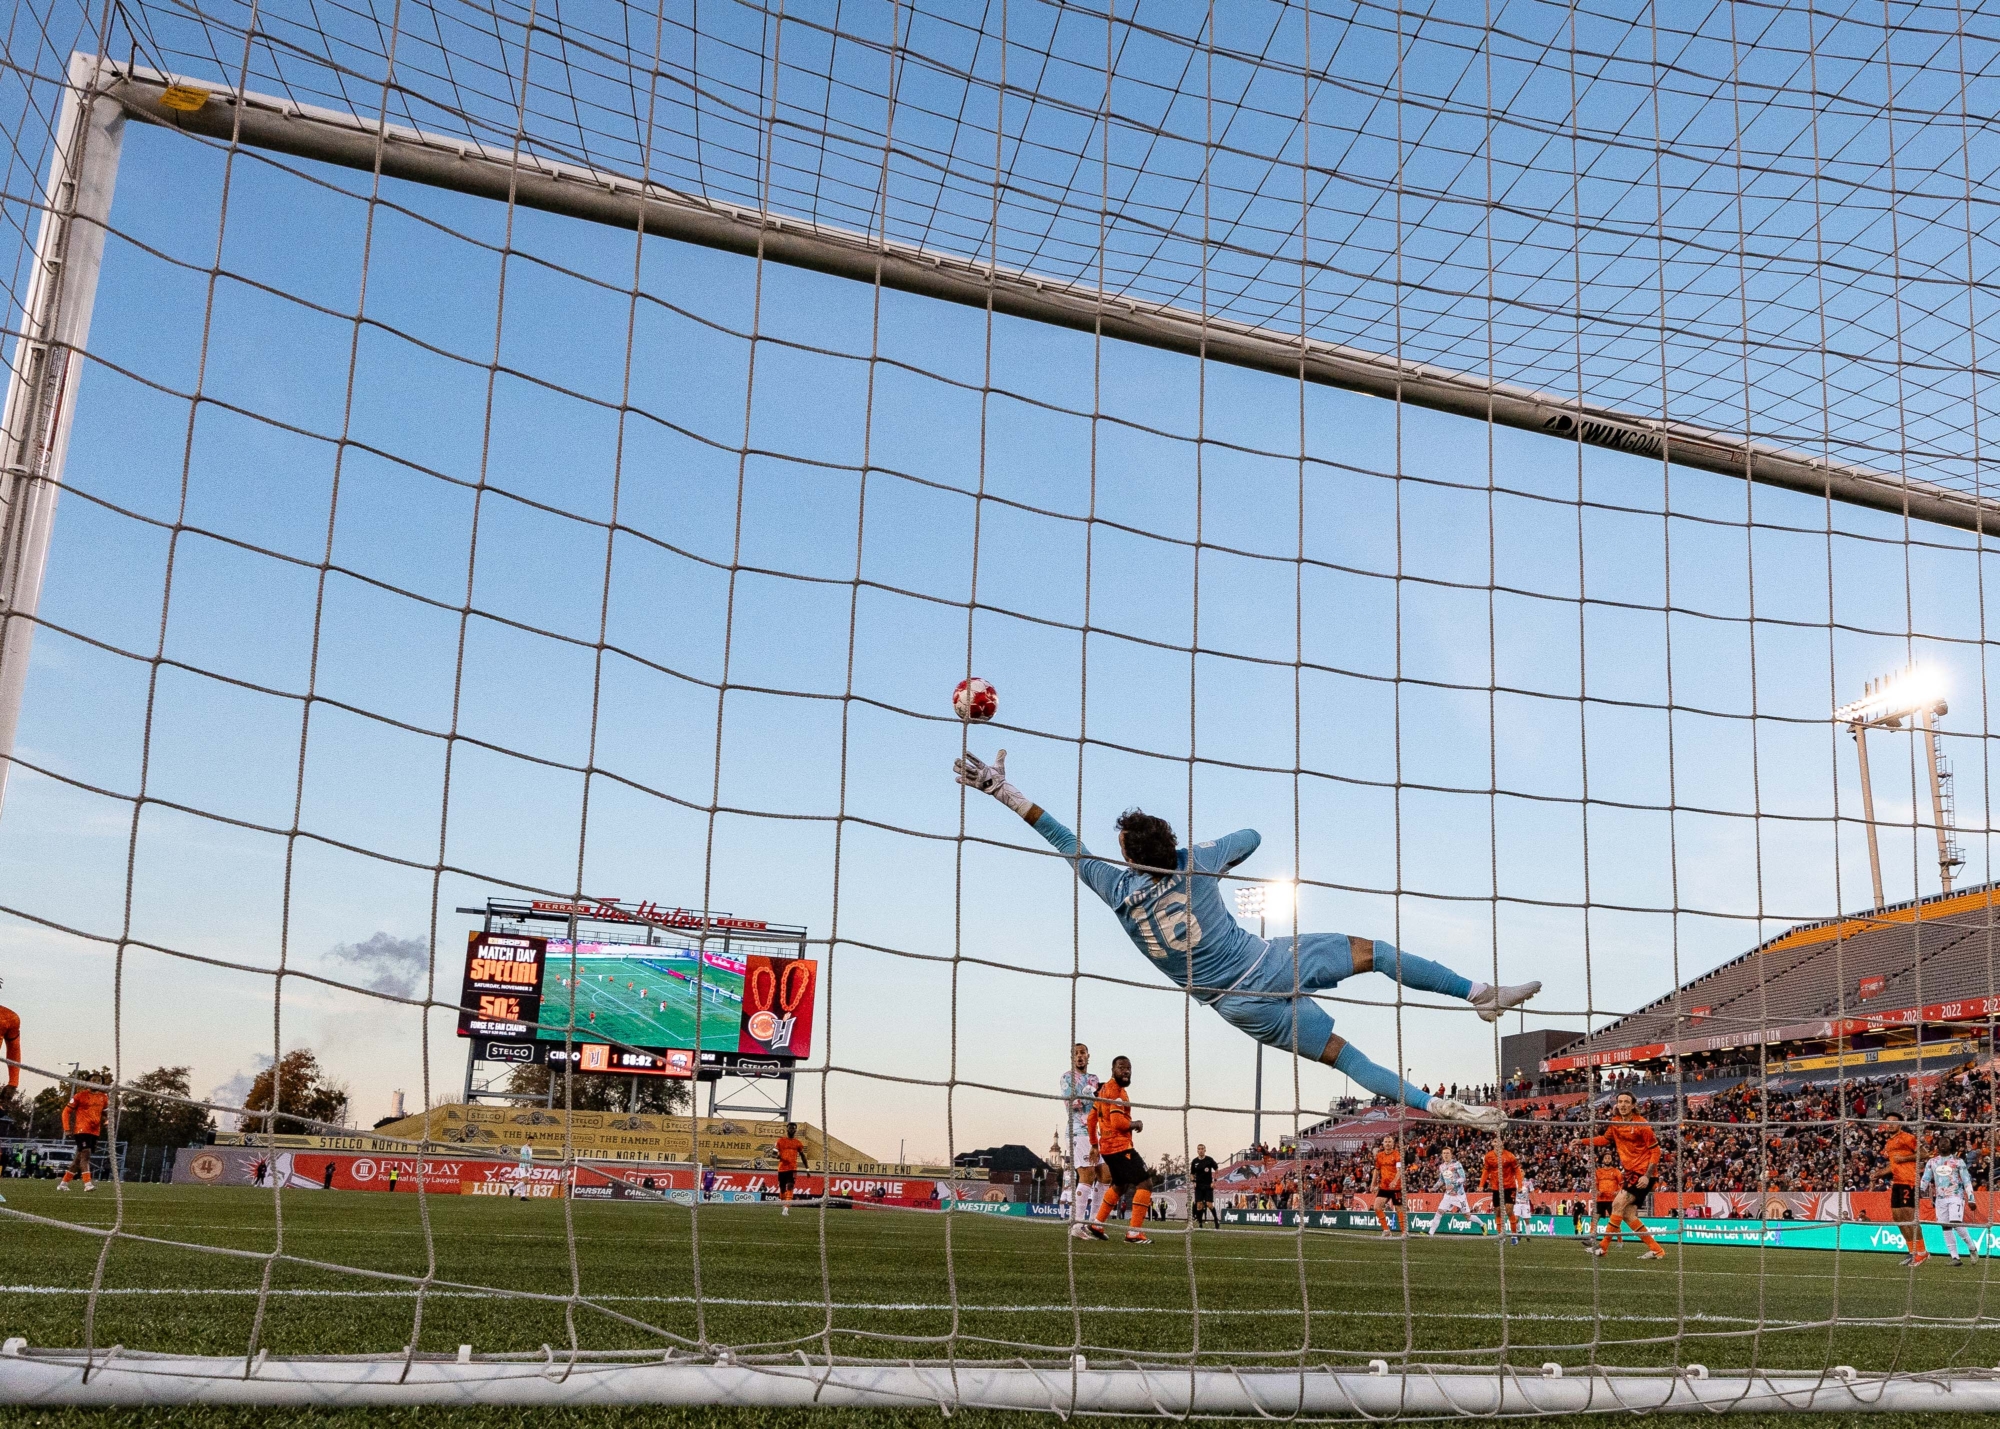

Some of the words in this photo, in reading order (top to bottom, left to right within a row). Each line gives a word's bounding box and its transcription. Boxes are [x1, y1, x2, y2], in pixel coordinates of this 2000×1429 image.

[538, 902, 585, 912] TERRAN
[723, 919, 760, 929] FIELD
[1131, 891, 1202, 959] 16
[478, 945, 514, 961] MATCH
[516, 948, 537, 963] DAY
[470, 958, 538, 984] SPECIAL
[1941, 1003, 1962, 1018] 2022
[1708, 1036, 1729, 1049] FORGE
[1733, 1035, 1740, 1044] FC
[1743, 1029, 1781, 1045] HAMITON
[492, 1047, 529, 1057] STELCO
[1602, 1052, 1611, 1063] WE
[1613, 1049, 1632, 1061] FORGE
[612, 1054, 618, 1064] 1
[471, 1112, 501, 1120] STELCO
[503, 1130, 521, 1139] THE
[525, 1131, 565, 1141] HAMMER
[758, 1127, 785, 1135] STELCO
[320, 1137, 363, 1149] STELCO
[600, 1135, 617, 1144] THE
[621, 1136, 660, 1146] HAMMER
[694, 1140, 710, 1148] HE
[713, 1141, 752, 1150] HAMMER
[616, 1150, 650, 1161] NORTH
[657, 1152, 677, 1162] END
[379, 1160, 463, 1176] FINDLAY
[816, 1161, 850, 1173] SELCO
[858, 1163, 887, 1174] NORTH
[895, 1165, 911, 1175] END
[432, 1176, 460, 1184] Lawyers
[533, 1184, 554, 1197] 837
[575, 1187, 613, 1195] CARSTAR
[1903, 1190, 1910, 1199] 2
[913, 1200, 933, 1208] one
[958, 1202, 1000, 1212] WESTJET
[1957, 1204, 1961, 1213] 7
[1453, 1218, 1472, 1231] Degree
[1694, 1224, 1719, 1239] Won't
[1723, 1225, 1739, 1240] Let
